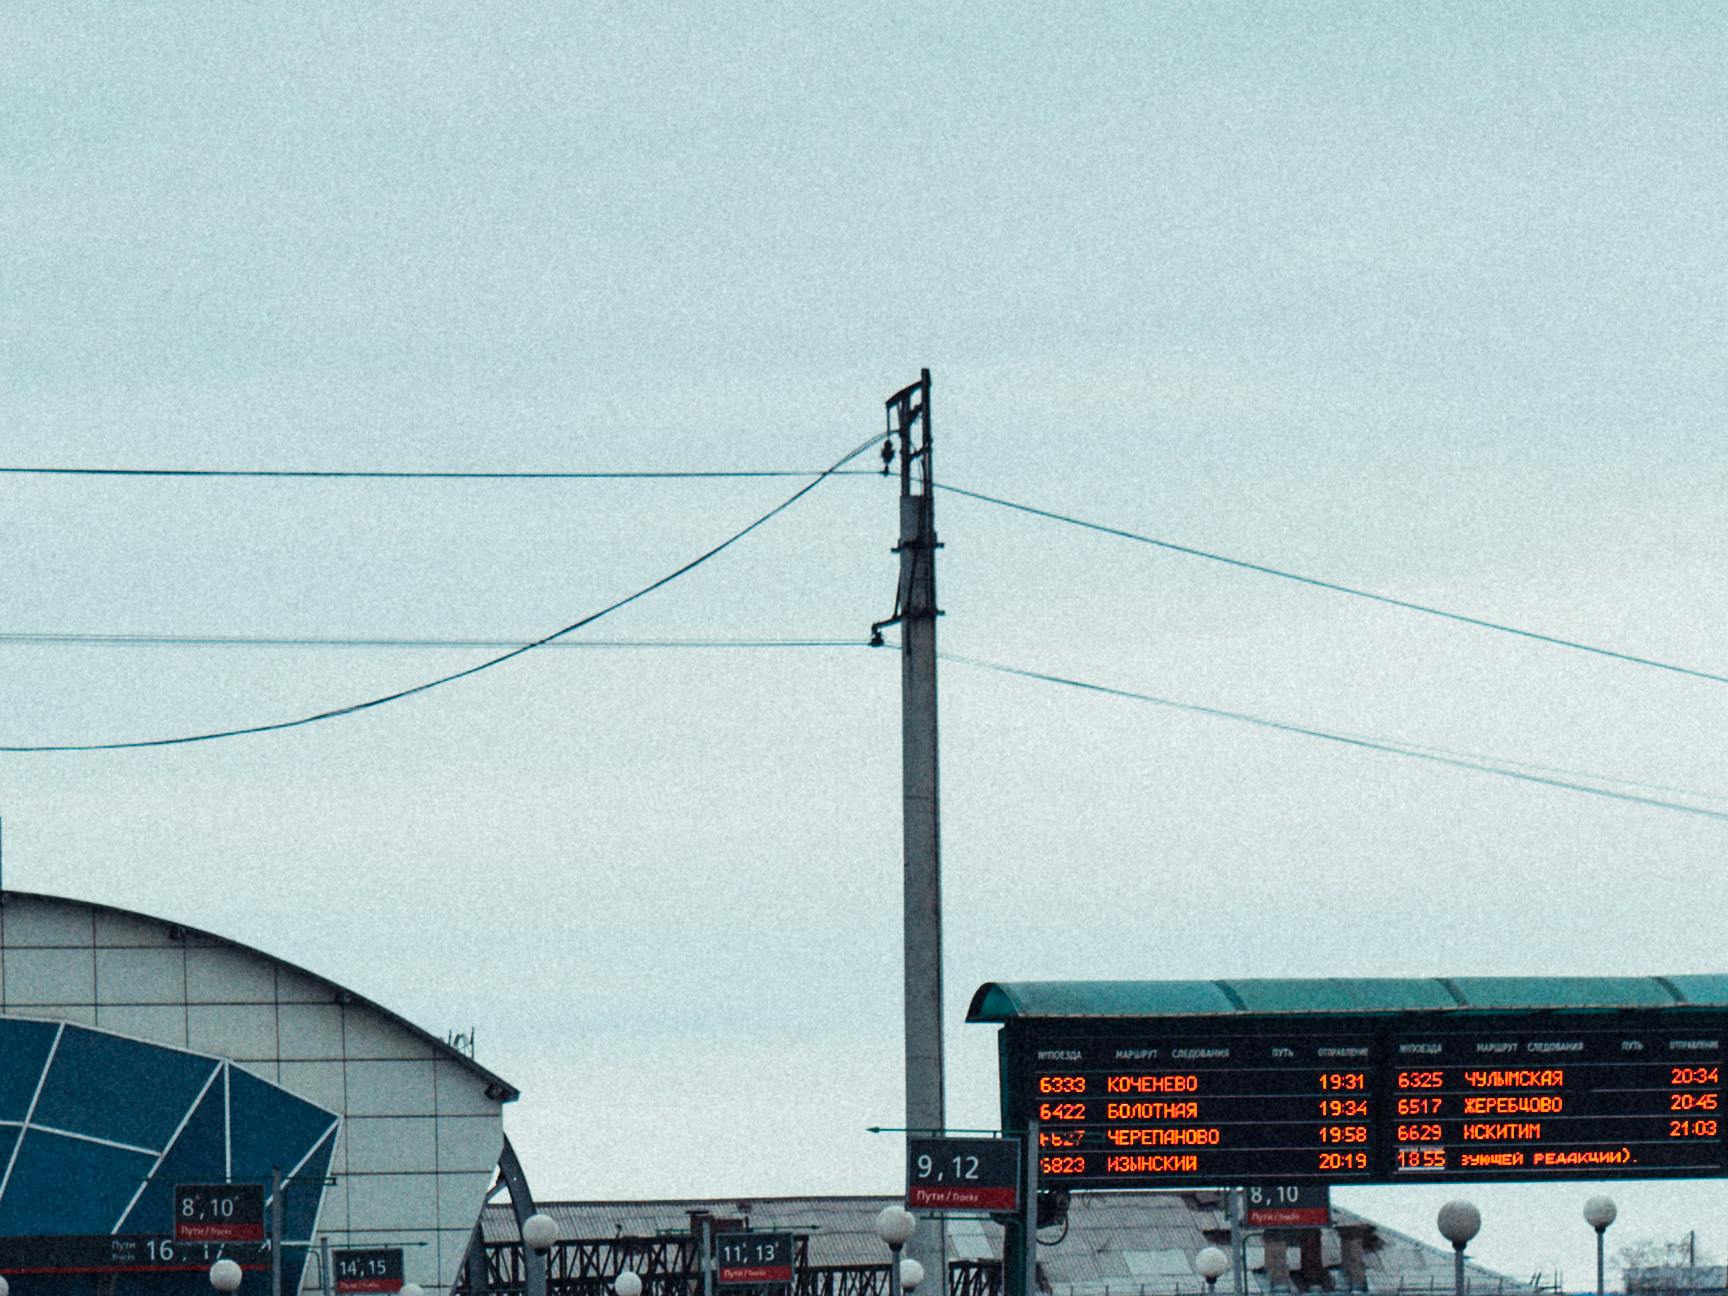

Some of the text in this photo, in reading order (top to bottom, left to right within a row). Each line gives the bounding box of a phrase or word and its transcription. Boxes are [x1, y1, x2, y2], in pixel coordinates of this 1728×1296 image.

[1115, 1049, 1158, 1060] МАРШРУТ
[1172, 1048, 1229, 1060] СЛЕДОВАНИЯ
[1272, 1048, 1294, 1058] ПУТЬ
[1039, 1073, 1365, 1093] 6333 КОЧЕНЕВО 19:31
[1398, 1067, 1719, 1089] 6325 ЧУЛЫМСКАЯ 20:34
[1039, 1100, 1368, 1120] 6422 БОЛОТНАЯ 19:34
[1398, 1093, 1718, 1115] 6517 ЖЕРЕБЦОВО 20:45
[1107, 1128, 1220, 1146] ЧЕРЕПАНОВО
[1319, 1126, 1368, 1143] 19:58
[1398, 1119, 1718, 1141] 6629 ИСКИТИМ 21:03
[1040, 1153, 1368, 1174] 6823 ИЗЫНСКИЙ 20:19
[1533, 1147, 1638, 1166] РЕДАКЦИИ).
[916, 1189, 944, 1204] Пути
[180, 1226, 204, 1237] Пути
[111, 1240, 137, 1251] Пути
